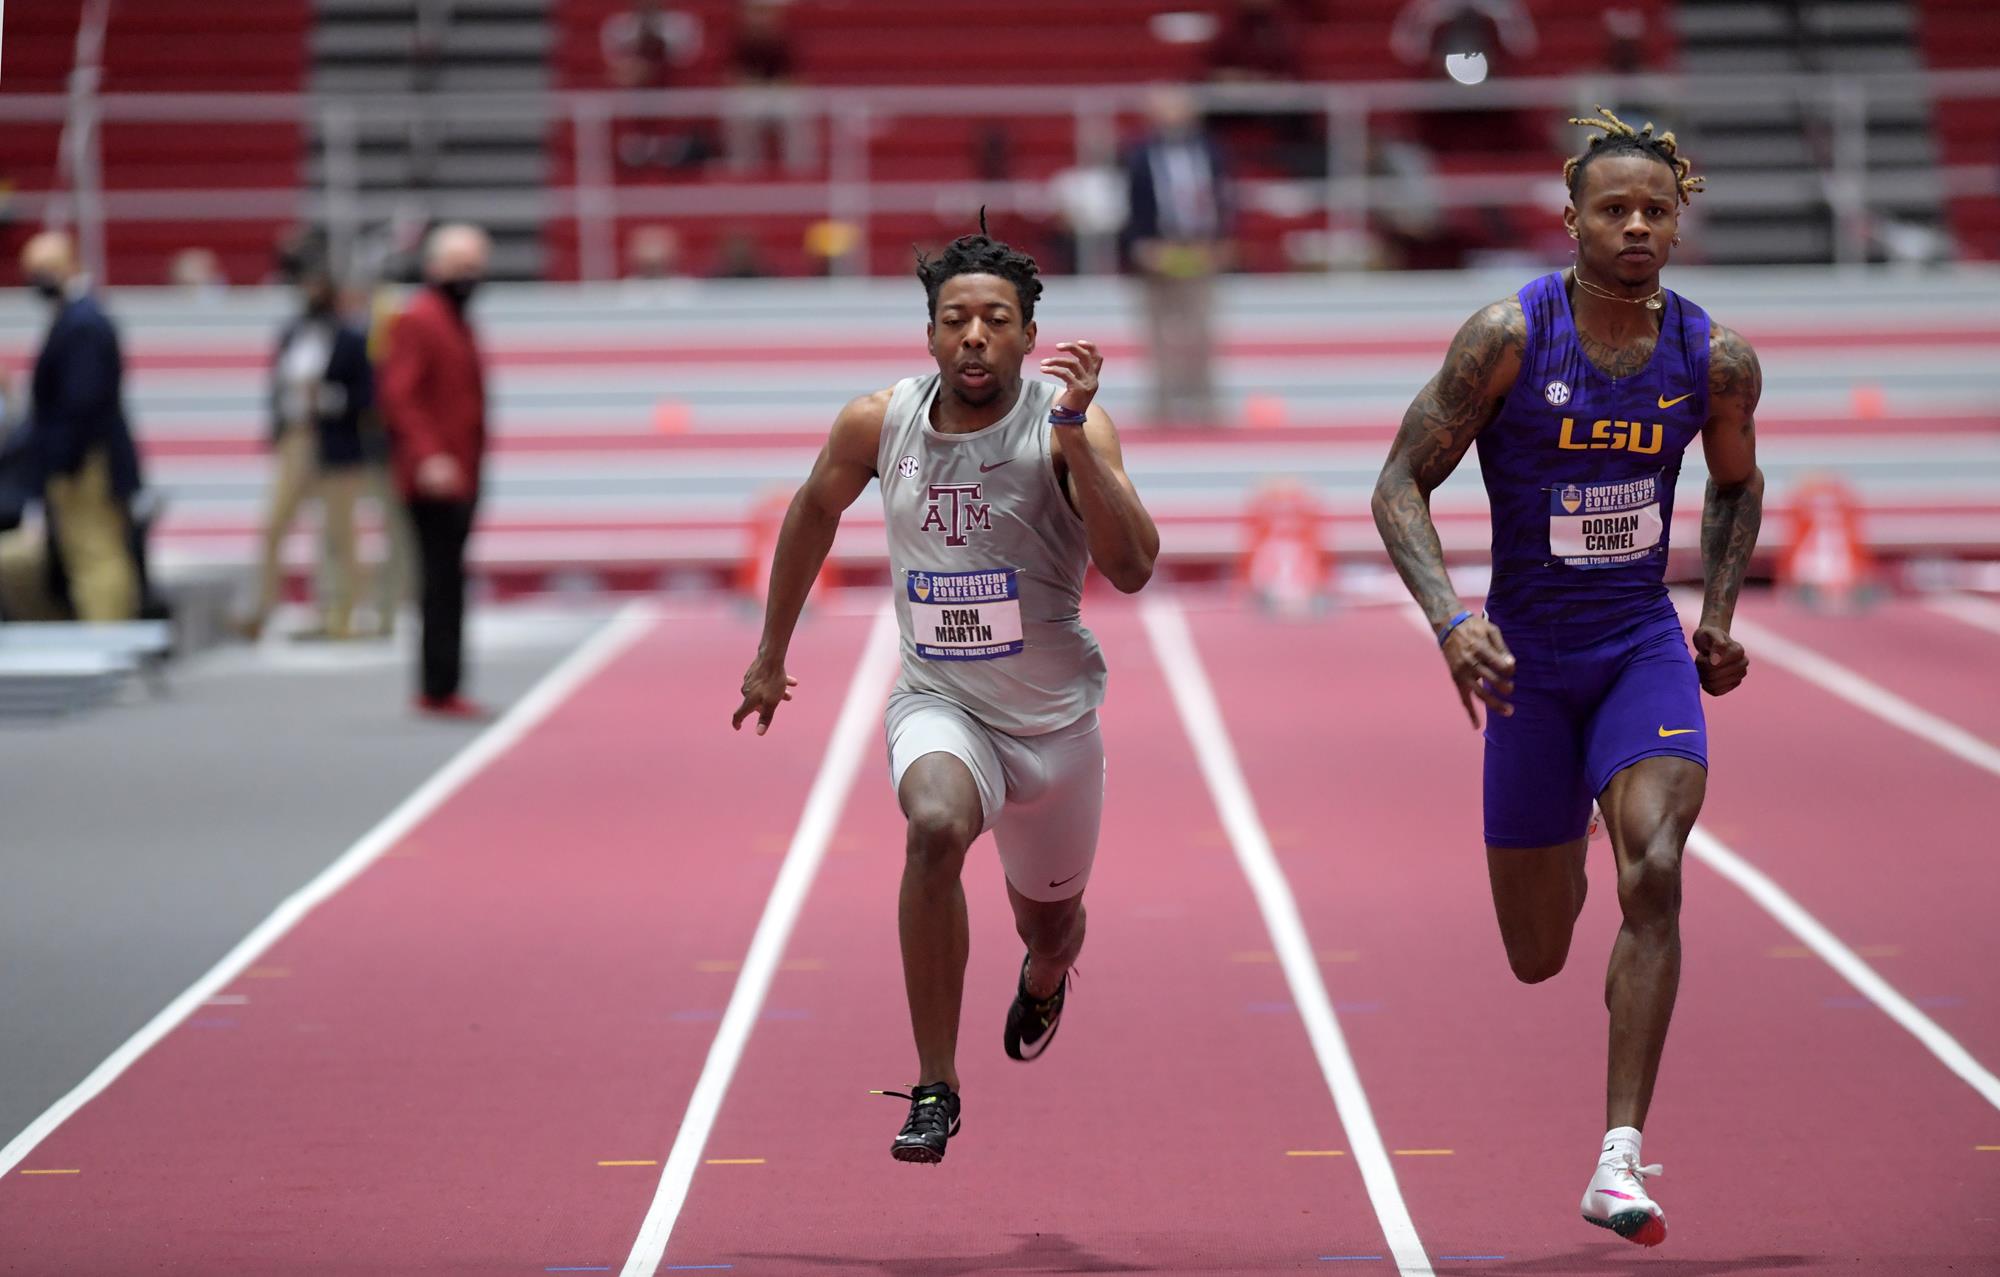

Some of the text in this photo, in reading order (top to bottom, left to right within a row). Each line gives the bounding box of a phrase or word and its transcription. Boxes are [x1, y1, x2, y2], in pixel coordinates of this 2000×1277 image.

[1547, 382, 1568, 404] SEC
[1558, 417, 1663, 455] LSU
[1585, 477, 1655, 498] SOUTHEASTERN
[1585, 487, 1656, 508] CONFERENCE
[1582, 514, 1639, 535] DORIAN
[1585, 533, 1635, 551] CAMEL
[932, 572, 1007, 587] SOUTHEASTERN
[932, 582, 1008, 597] CONFERENCE
[941, 608, 980, 626] RYAN
[935, 625, 993, 643] MARTIN
[986, 644, 1011, 655] CENTER
